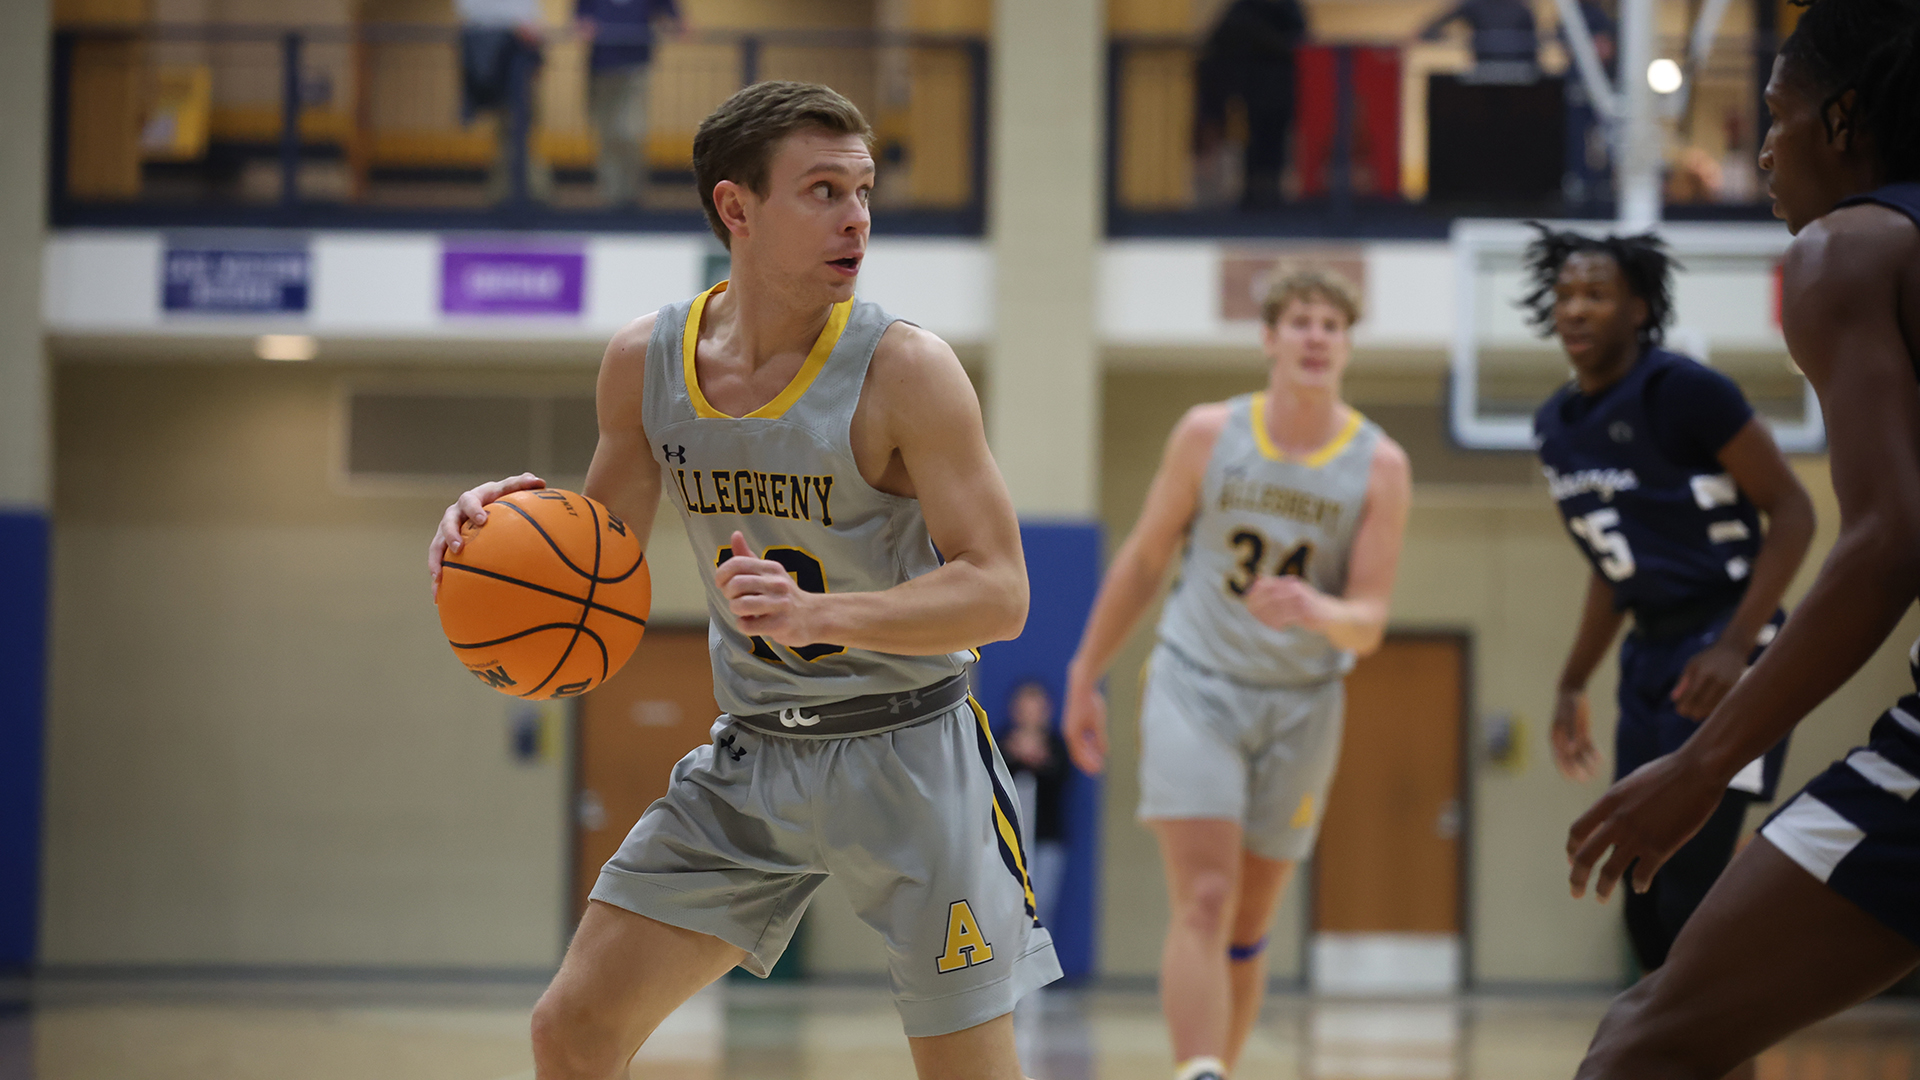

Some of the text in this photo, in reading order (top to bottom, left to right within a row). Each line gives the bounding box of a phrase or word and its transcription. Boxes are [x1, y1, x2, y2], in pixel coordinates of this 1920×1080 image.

[669, 467, 834, 527] LLEGHENY
[1226, 526, 1315, 597] 34
[1569, 507, 1636, 582] 5
[936, 899, 994, 974] A
